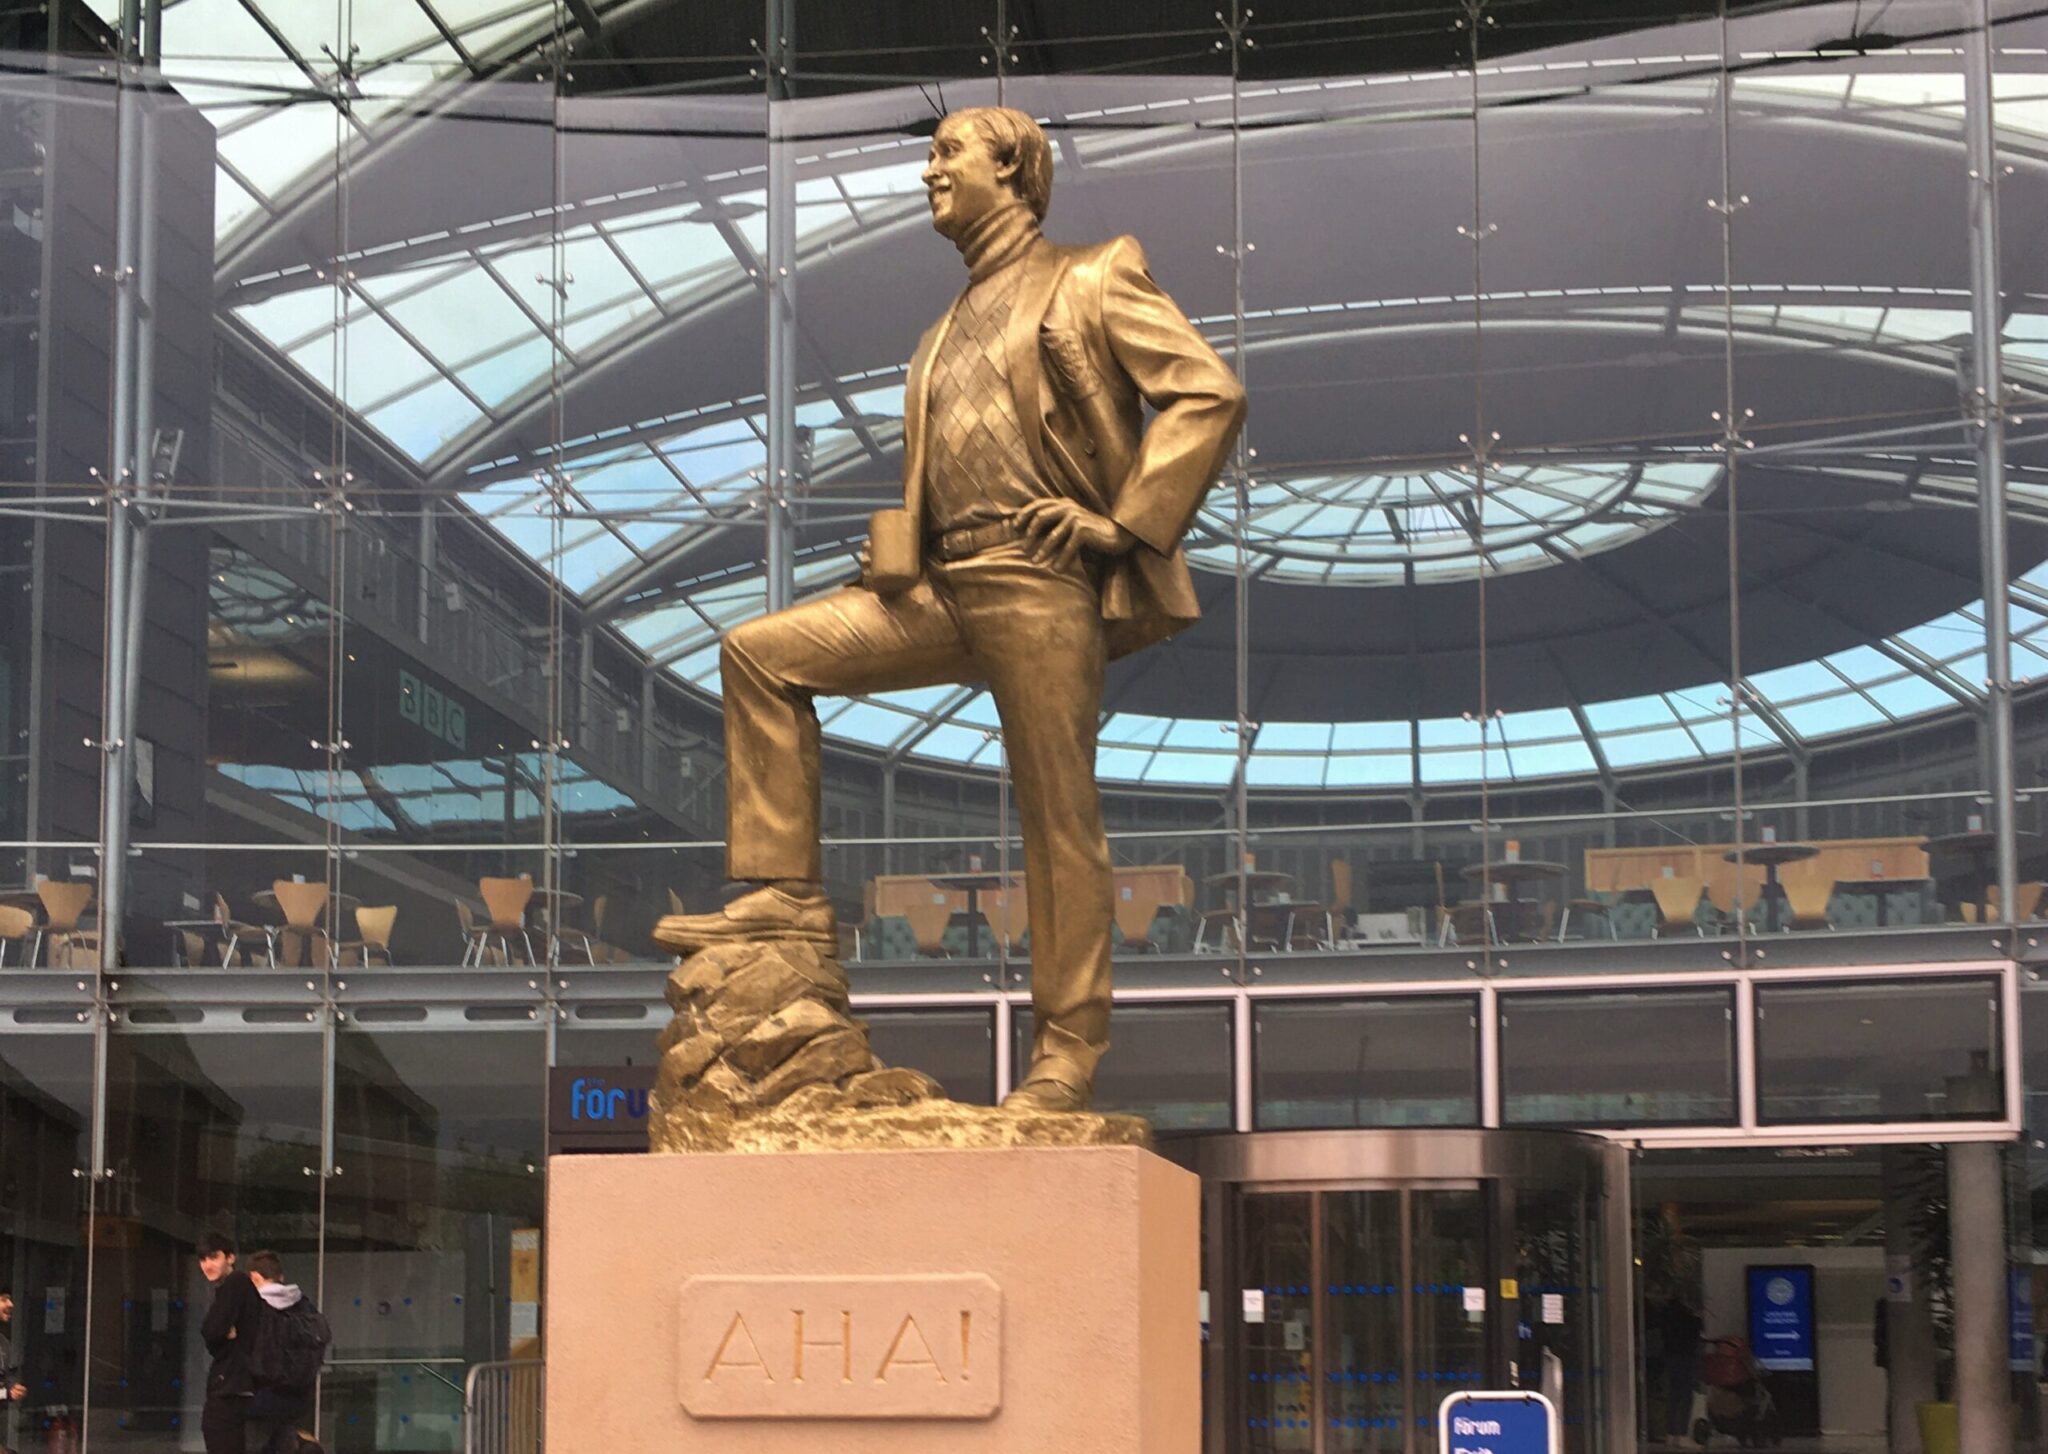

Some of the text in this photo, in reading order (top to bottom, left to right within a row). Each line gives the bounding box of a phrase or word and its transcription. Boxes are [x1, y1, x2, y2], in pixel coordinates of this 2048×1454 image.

[401, 673, 464, 746] BBC
[572, 1079, 647, 1120] foru
[702, 1309, 971, 1384] AHA!
